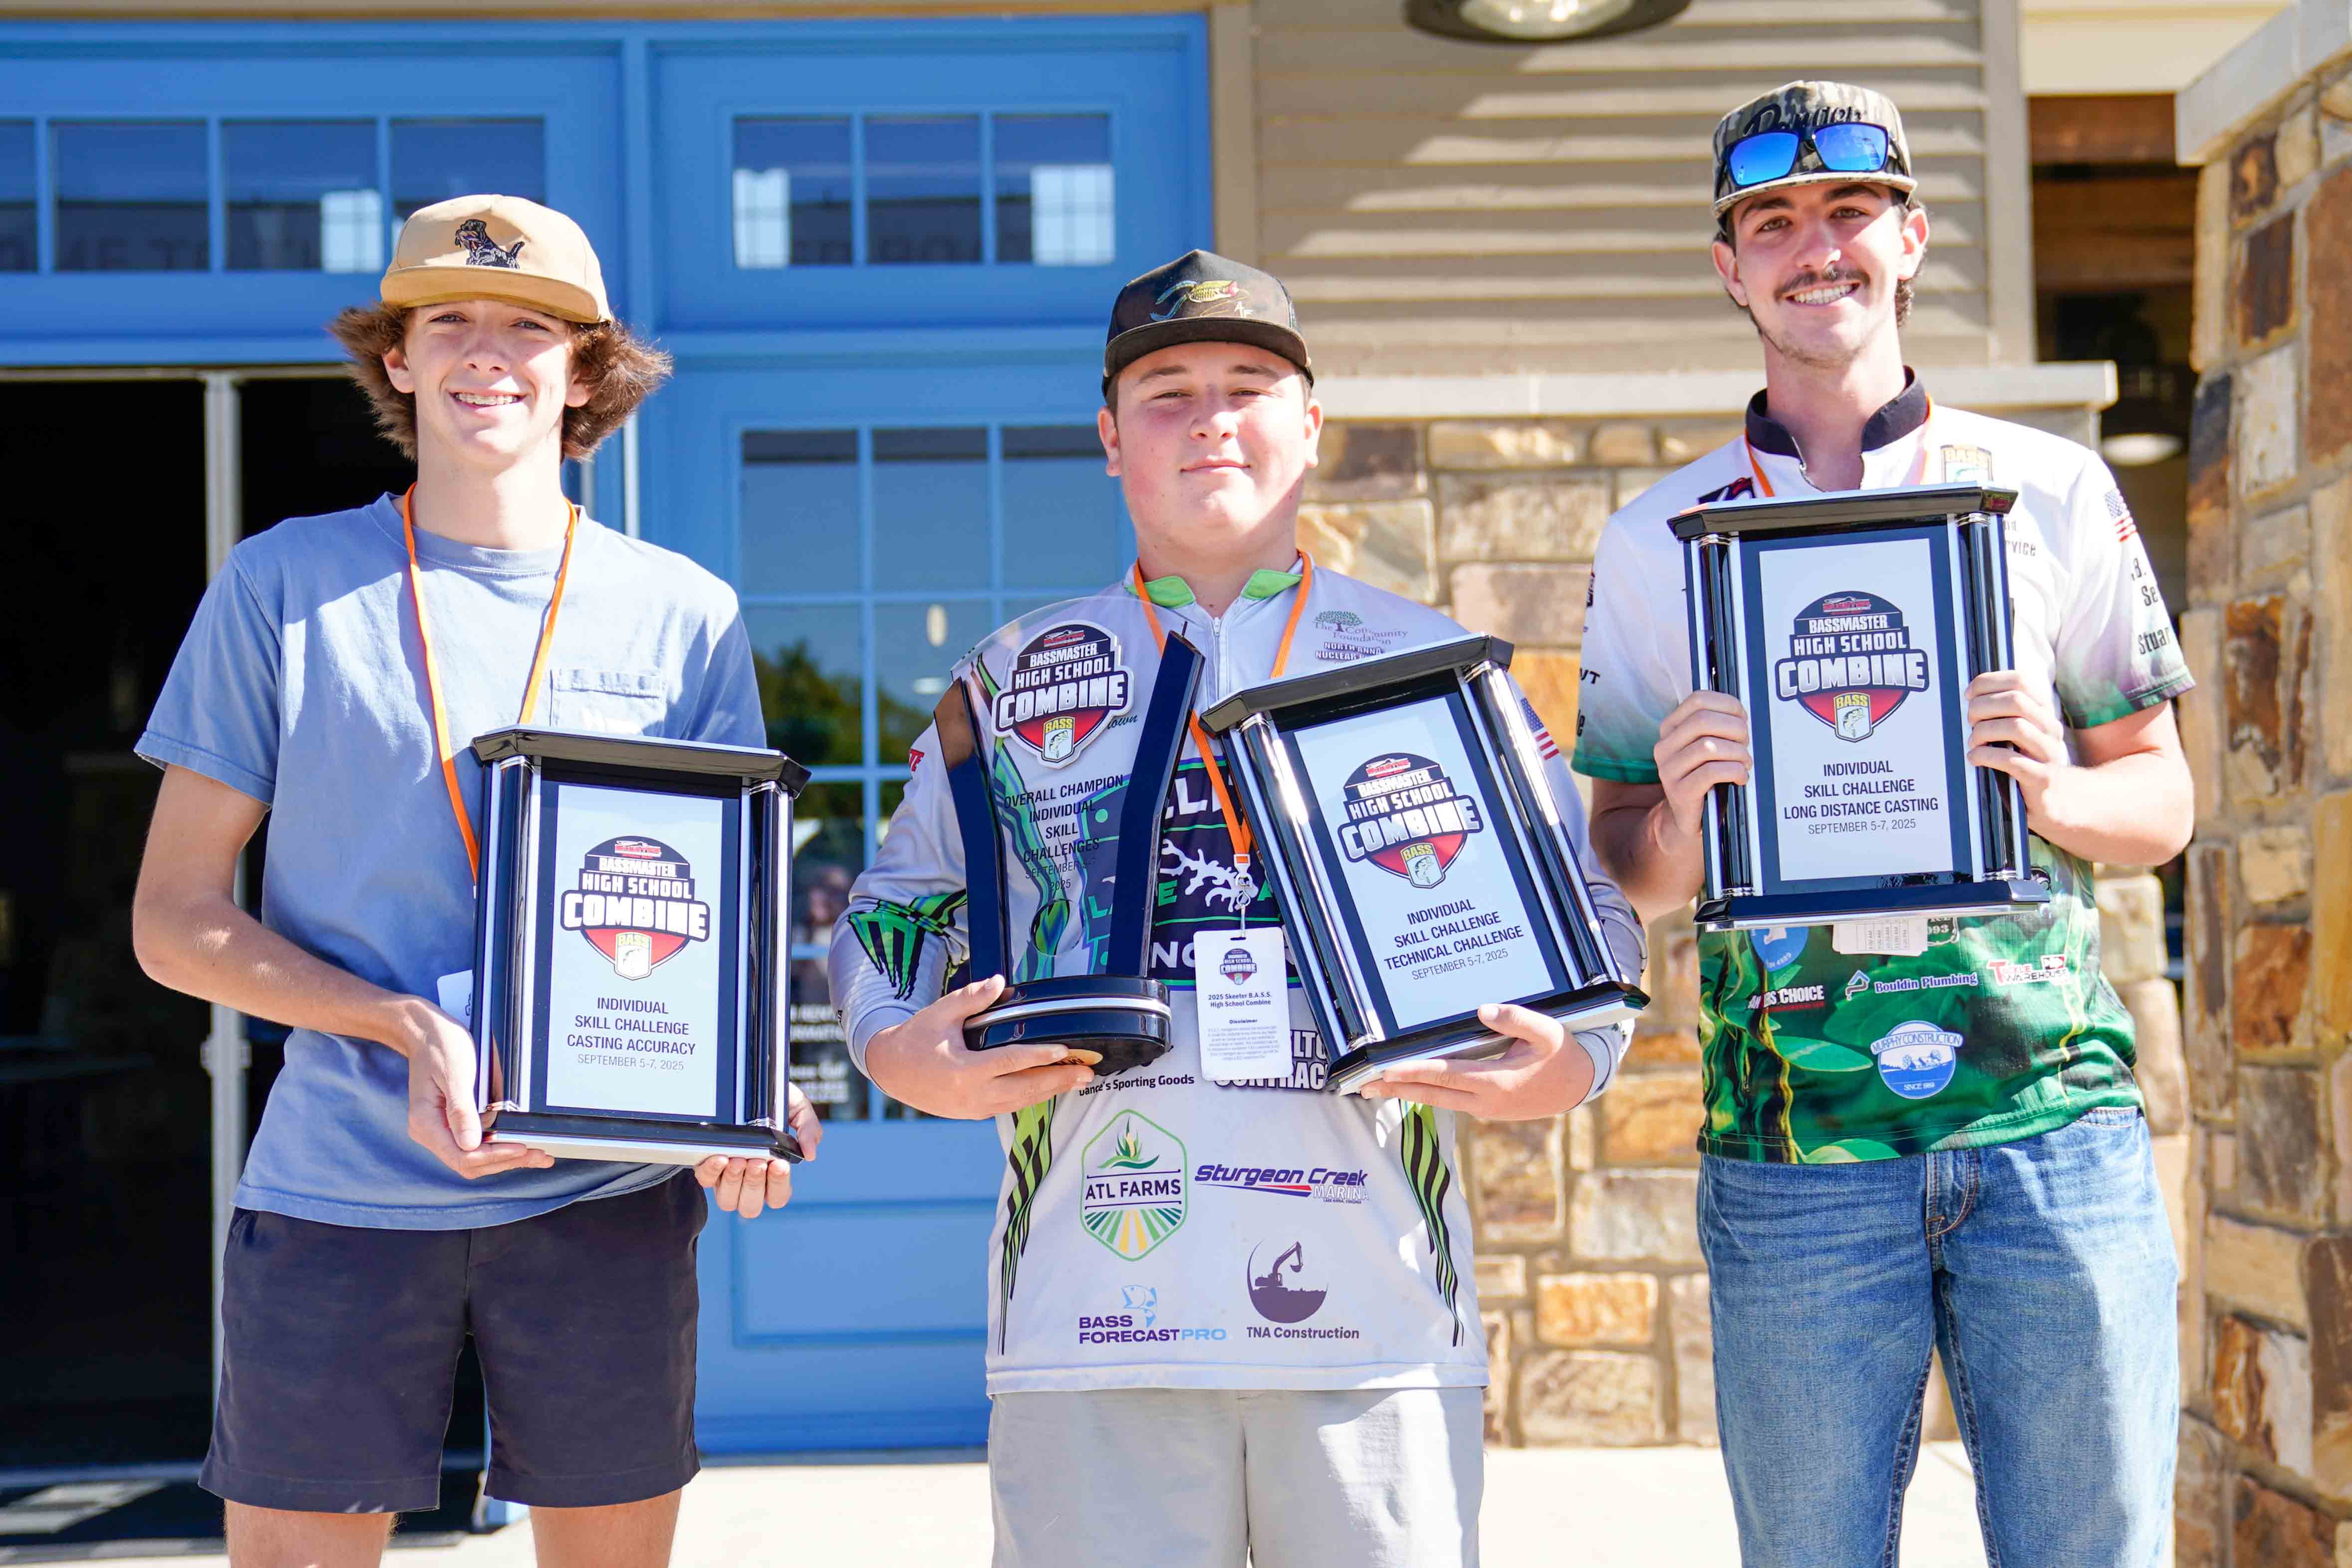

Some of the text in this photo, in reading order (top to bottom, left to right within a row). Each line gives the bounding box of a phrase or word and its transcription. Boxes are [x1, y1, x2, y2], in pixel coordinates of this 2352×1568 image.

[1313, 621, 1333, 631] The
[1808, 614, 1888, 634] BASSMASTER
[1324, 641, 1382, 655] NORTH ANNA
[1794, 631, 1907, 656] HIGH SCHOOL
[1029, 642, 1098, 668] BASSMASTER
[1315, 650, 1357, 660] NUCLEAR
[1014, 656, 1112, 690] HIGH SCHOOL
[1778, 652, 1926, 698] COMBINE
[998, 673, 1125, 729] COMBINE
[1836, 694, 1868, 709] BASS
[1045, 717, 1074, 732] BASS
[1823, 760, 1894, 777] INDIVIDUAL
[1004, 774, 1124, 809] OVERALL CHAMPION
[1357, 770, 1432, 798] BASSMASTER
[1804, 779, 1915, 798] SKILL CHALLENGE
[1029, 799, 1096, 823] INDIVIDUAL
[1349, 782, 1453, 820] HIGH SCHOOL
[1784, 797, 1939, 819] LONG DISTANCE CASTING
[1045, 822, 1078, 839] SKILL
[1342, 798, 1480, 859] COMBINE
[1808, 818, 1916, 834] SEPTEMBER 5-7, 2025
[1023, 838, 1100, 863] CHALLENGES
[1402, 844, 1434, 861] BASS
[598, 857, 677, 878] BASSMASTER
[1025, 860, 1079, 879] SEPTEMBER
[582, 872, 692, 899] HIGH SCHOOL
[1049, 878, 1071, 892] 2025
[563, 893, 707, 940] COMBINE
[1406, 899, 1476, 925] INDIVIDUAL
[1394, 911, 1501, 948] SKILL CHALLENGE
[1384, 926, 1524, 970] TECHNICAL CHALLENGE
[1411, 948, 1509, 980] SEPTEMBER 5-7, 2025
[1875, 973, 1977, 993] Bouldin Plumbing
[1779, 985, 1825, 1004] CHOICE
[597, 997, 669, 1014] INDIVIDUAL
[575, 1015, 689, 1035] SKILL CHALLENGE
[567, 1034, 696, 1055] CASTING ACCURACY
[1872, 1032, 1961, 1052] MURPHY CONSTRUCTION
[578, 1054, 684, 1071] SEPTEMBER 5-7, 2025
[1113, 1076, 1156, 1091] Sporting
[1158, 1074, 1195, 1085] Goods
[1194, 1164, 1369, 1187] Sturgeon Creek
[1085, 1178, 1181, 1200] ATL FARMS
[1313, 1184, 1370, 1201] MARINA
[1079, 1315, 1133, 1329] BASS
[1246, 1326, 1360, 1339] TNA Construction
